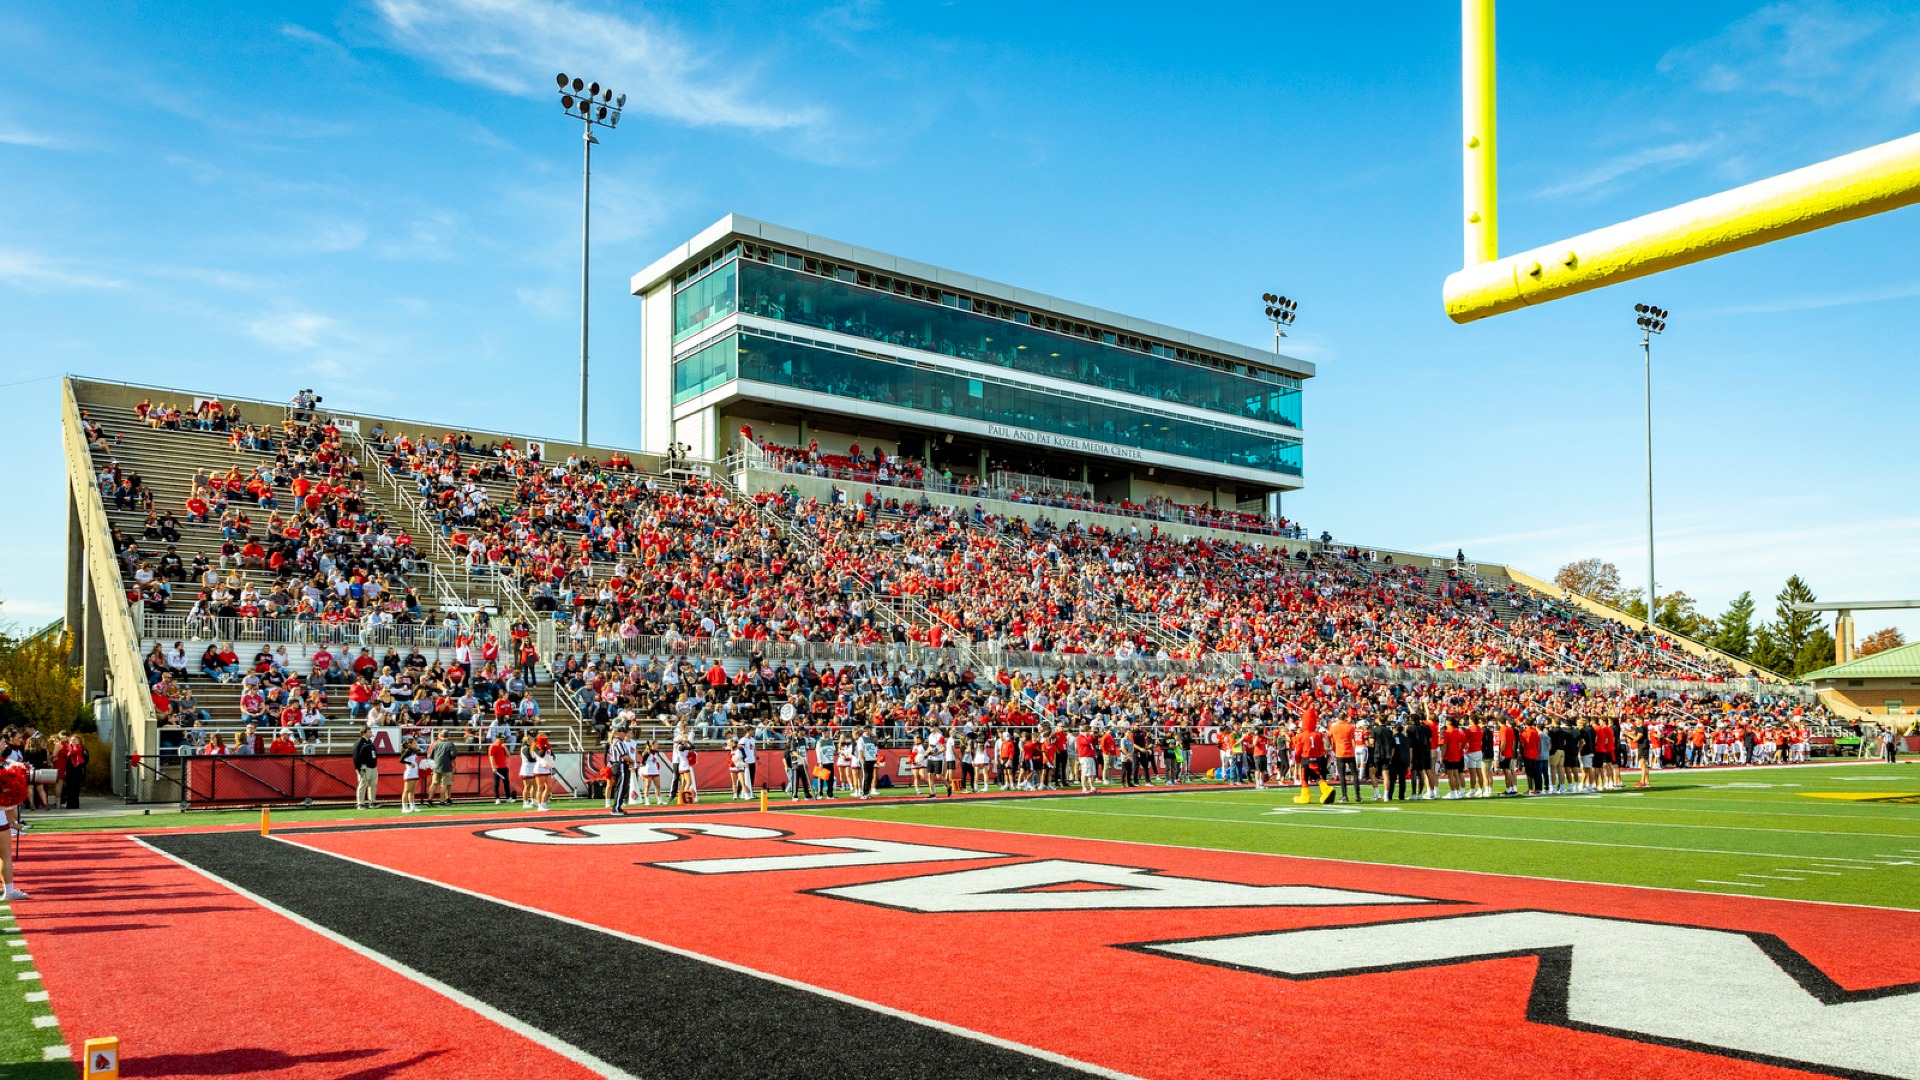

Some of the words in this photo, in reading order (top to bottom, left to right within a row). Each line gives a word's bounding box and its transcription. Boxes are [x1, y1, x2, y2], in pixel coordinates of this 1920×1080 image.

[988, 425, 1010, 438] PAUL
[1013, 430, 1034, 441] AND
[1037, 432, 1051, 445] PAT
[1054, 436, 1080, 449] KOZEL
[1082, 441, 1110, 454] MEDIA
[1111, 445, 1142, 459] CENTER
[373, 731, 395, 753] A
[1309, 736, 1315, 748] 1
[682, 791, 693, 804] G
